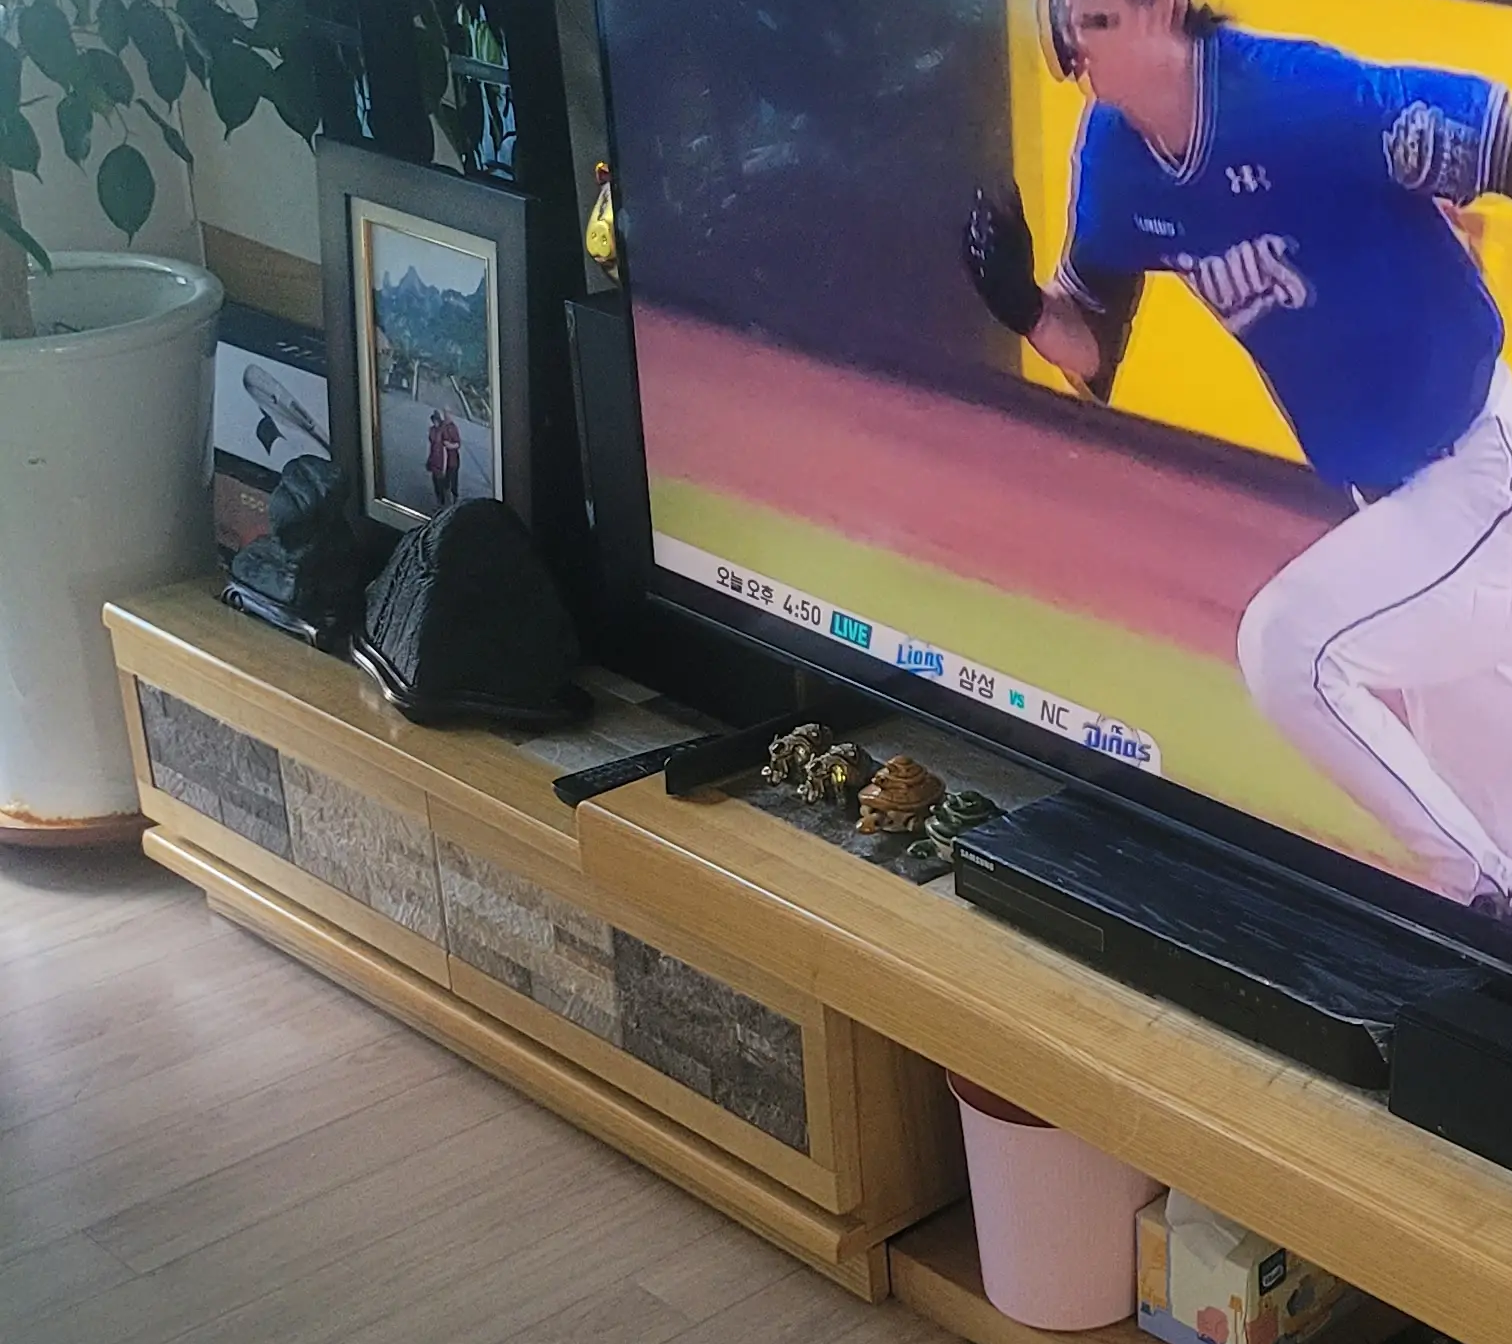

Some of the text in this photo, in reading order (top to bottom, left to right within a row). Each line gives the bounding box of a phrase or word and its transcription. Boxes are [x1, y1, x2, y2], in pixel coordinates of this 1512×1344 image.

[1160, 233, 1317, 336] ions
[716, 565, 744, 594] 오늘
[746, 578, 775, 606] 오후
[782, 593, 822, 626] 4:50
[833, 612, 870, 646] LIVE
[895, 643, 944, 677] Lions
[958, 665, 996, 699] 삼성
[1040, 699, 1070, 731] NC
[960, 848, 995, 872] SAMSUNG
